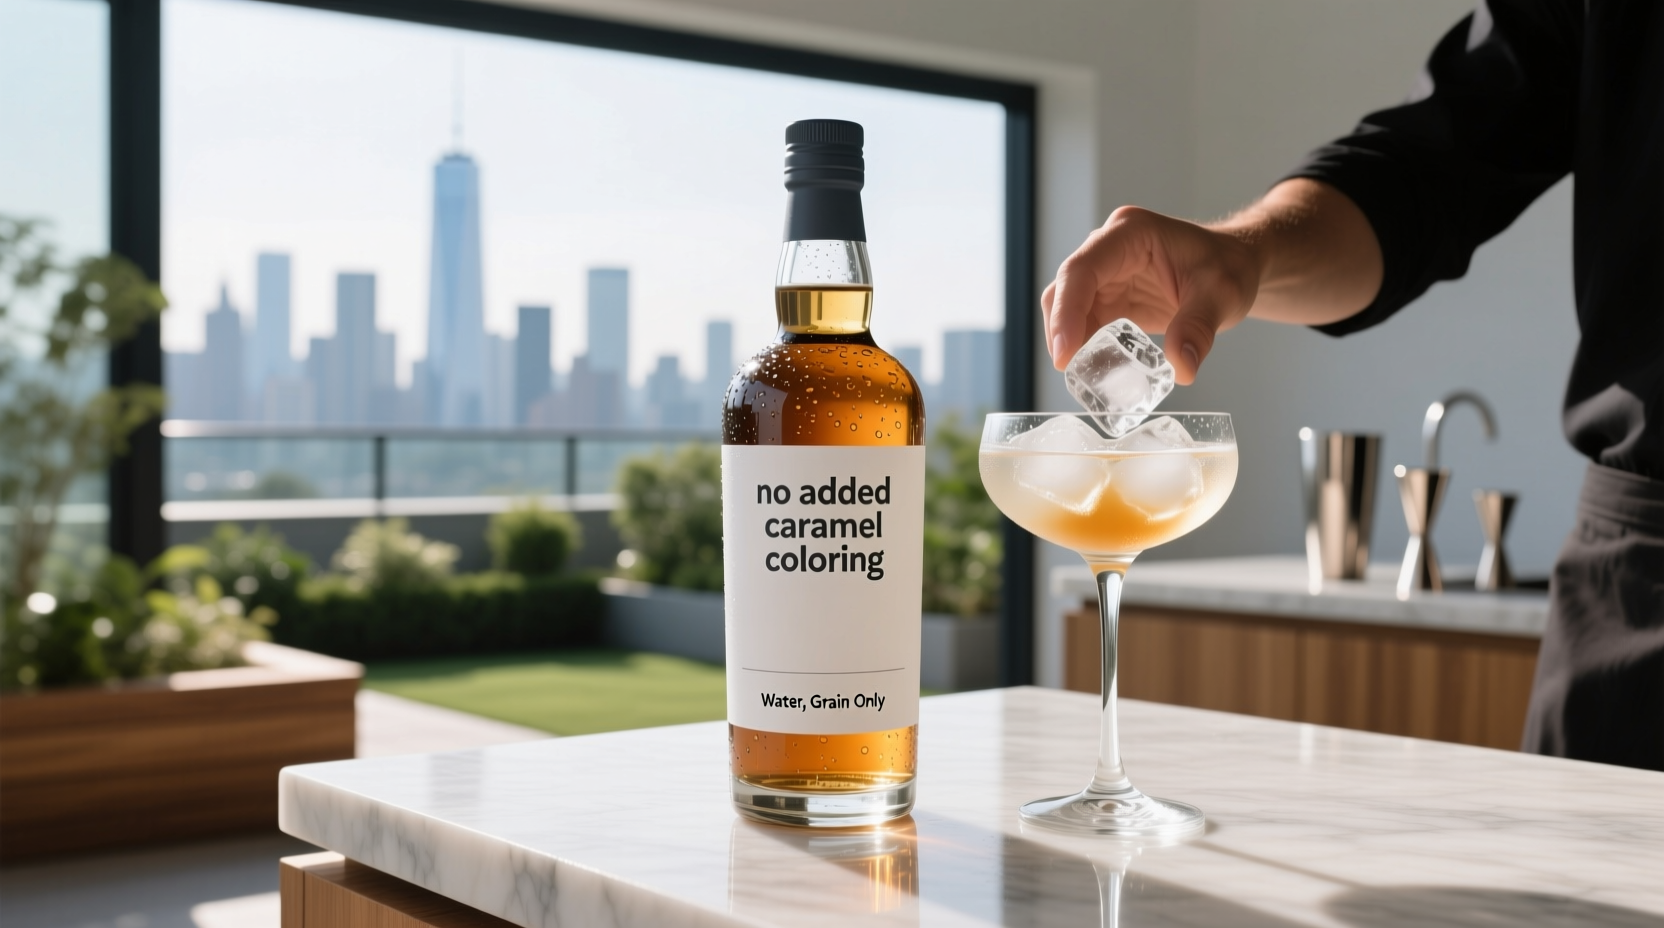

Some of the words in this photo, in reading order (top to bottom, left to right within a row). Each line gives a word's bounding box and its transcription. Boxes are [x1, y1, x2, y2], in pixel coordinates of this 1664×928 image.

[757, 484, 792, 505] no
[799, 476, 891, 505] added
[764, 511, 883, 539] caramel
[765, 544, 885, 581] coloring
[761, 692, 807, 713] Water,
[810, 694, 850, 709] Grain
[854, 692, 886, 711] Only
